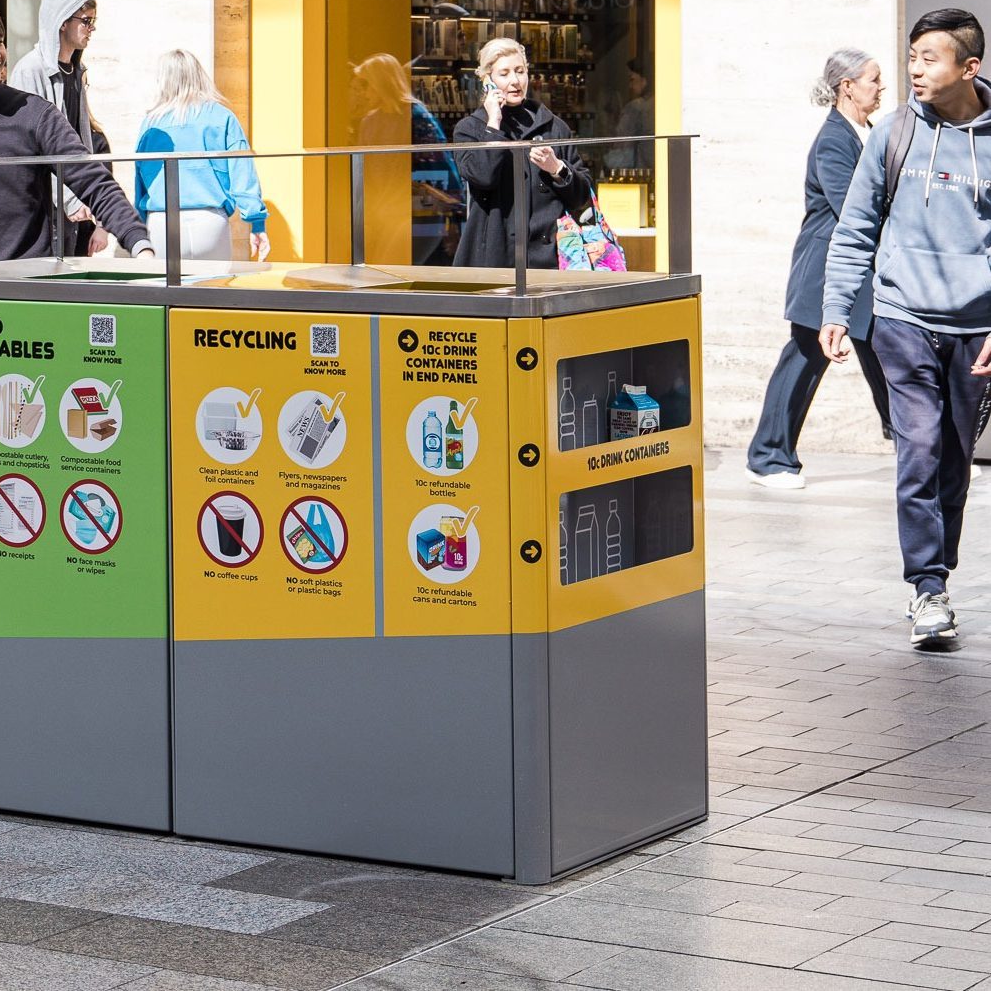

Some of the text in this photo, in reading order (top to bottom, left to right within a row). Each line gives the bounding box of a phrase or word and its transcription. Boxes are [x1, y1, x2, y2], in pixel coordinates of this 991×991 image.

[900, 168, 935, 179] OMMY
[194, 329, 296, 350] RECYCLING
[429, 331, 477, 343] RECYCLE
[422, 345, 477, 357] 10c DRINK
[84, 356, 102, 364] KNOW
[406, 358, 477, 370] CONTAINERS
[304, 367, 346, 376] KNOW MORE
[403, 371, 477, 384] IN END PANEL
[25, 452, 48, 461] cutlery,
[588, 441, 669, 470] 10c DRINK CONTAINERS
[16, 459, 50, 469] chopsticks
[61, 456, 121, 466] Compostable food
[61, 464, 121, 474] service containers
[199, 467, 218, 475] Clean
[221, 468, 243, 477] plastic
[217, 477, 255, 485] containers
[279, 472, 347, 483] Flyers, newspapers
[285, 480, 340, 491] and magazines
[415, 479, 471, 489] 10c refundable
[429, 489, 456, 498] bottles
[8, 551, 35, 560] receipts
[79, 558, 93, 566] face
[299, 578, 313, 586] soft
[315, 579, 342, 587] plastics
[297, 586, 321, 595] plastic
[323, 588, 341, 597] bags
[417, 587, 472, 597] 10c refundable
[413, 595, 477, 607] cans and cartons
